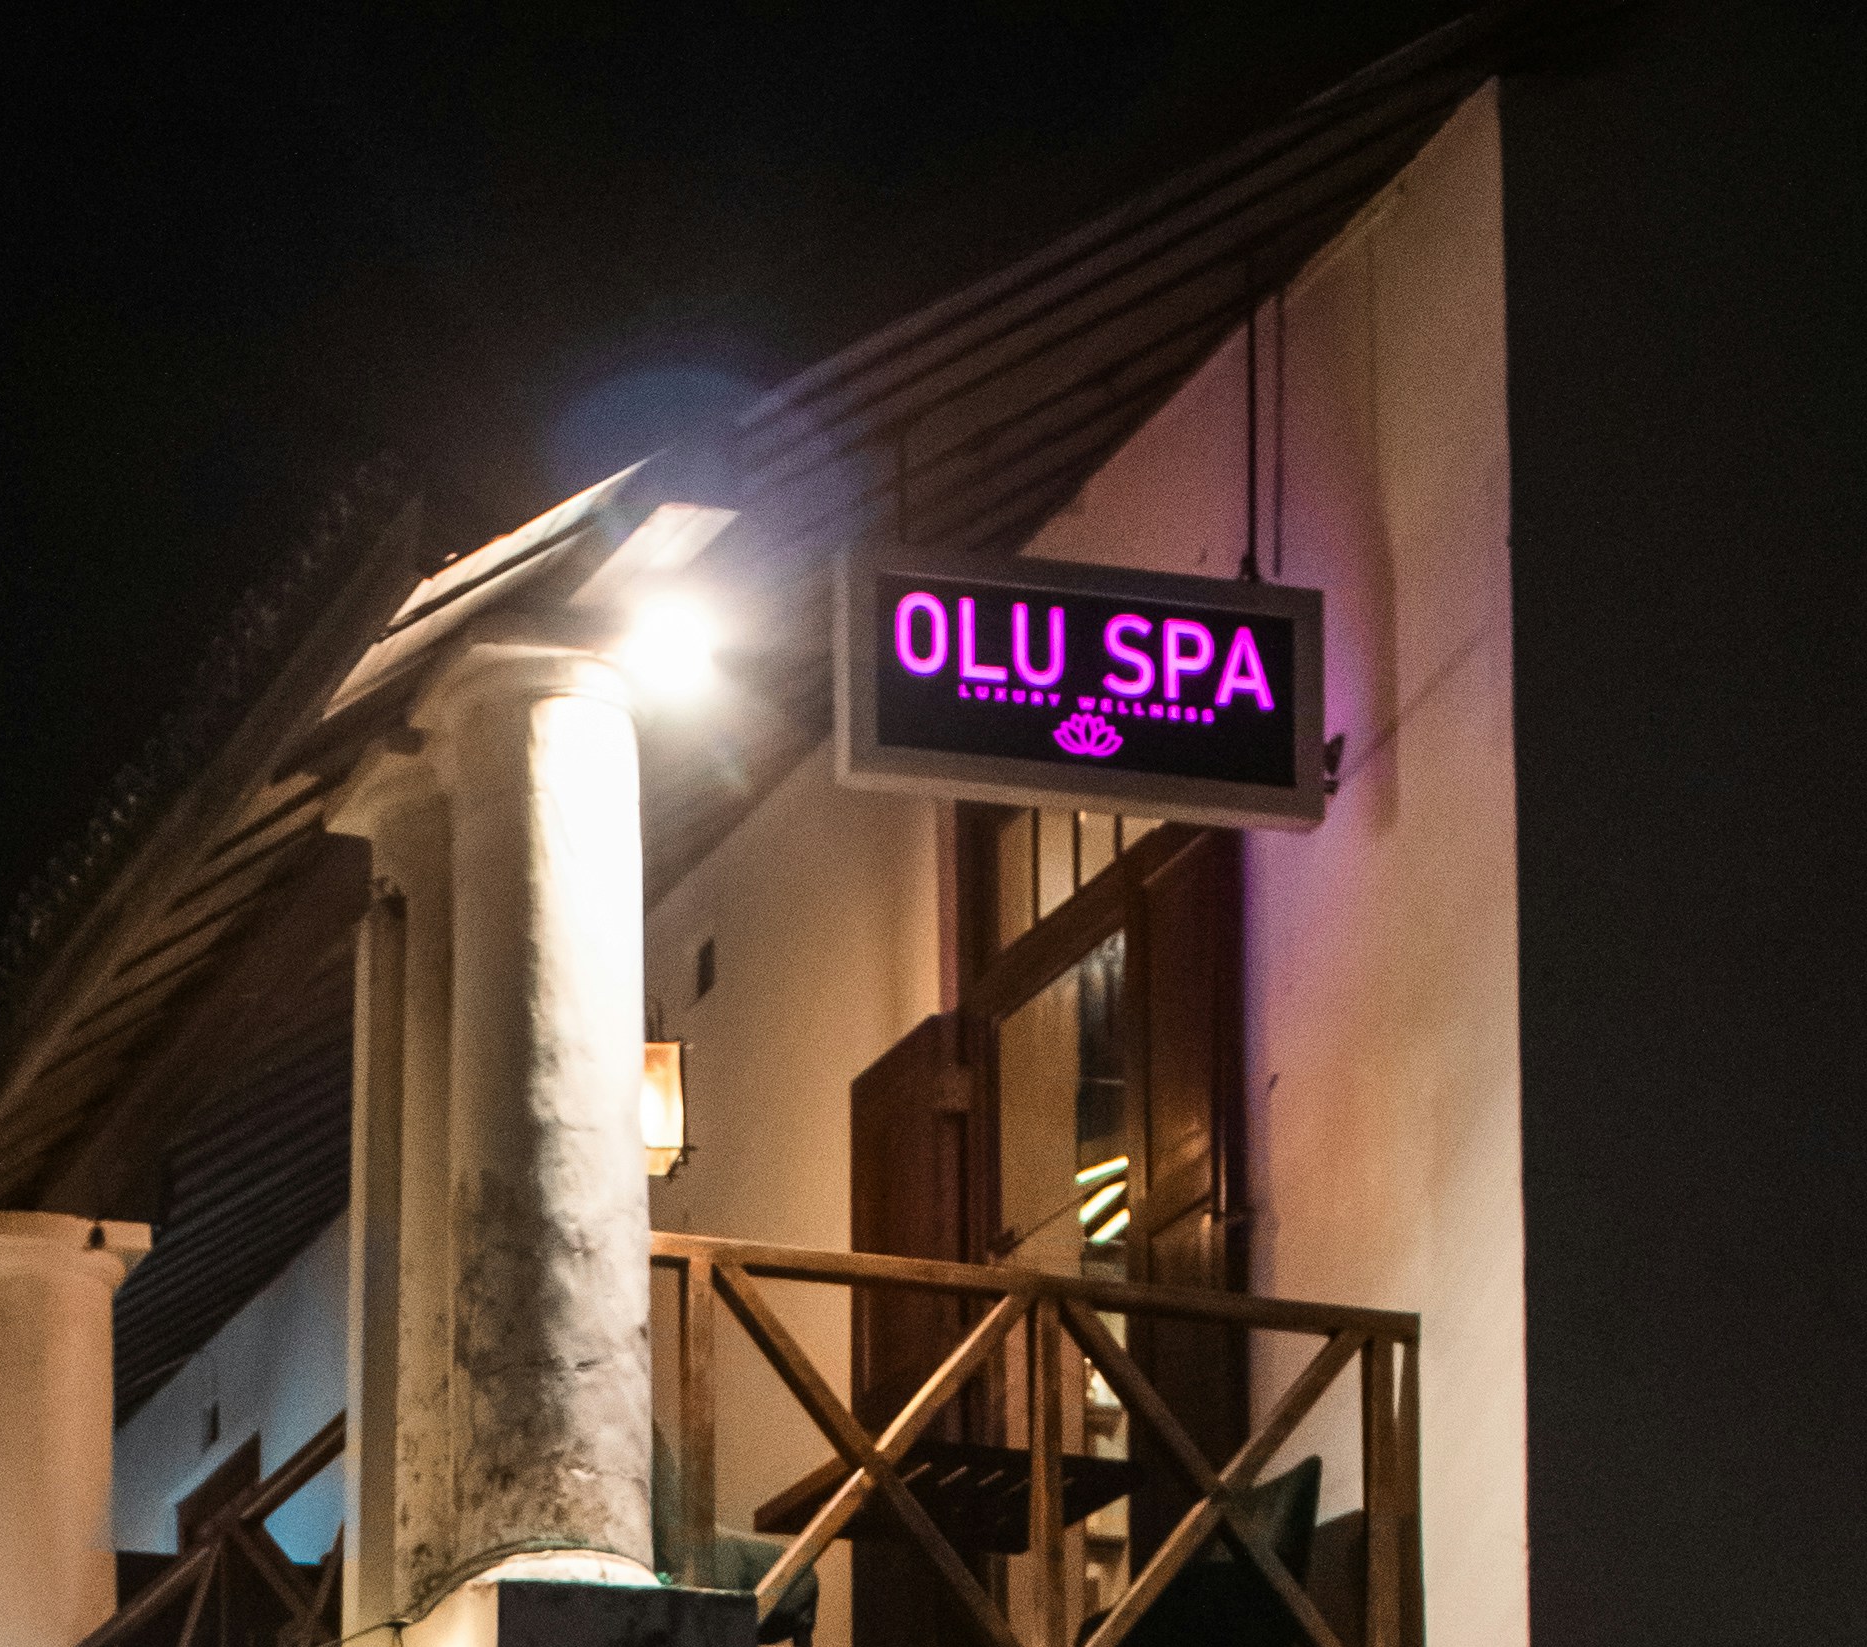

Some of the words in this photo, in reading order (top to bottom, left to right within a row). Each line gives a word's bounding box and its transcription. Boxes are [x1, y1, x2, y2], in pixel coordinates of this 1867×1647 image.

[895, 591, 1067, 687] OLU
[1103, 612, 1276, 712] SPA
[957, 683, 1062, 708] LUXURY
[1077, 695, 1217, 725] WELLNESS
